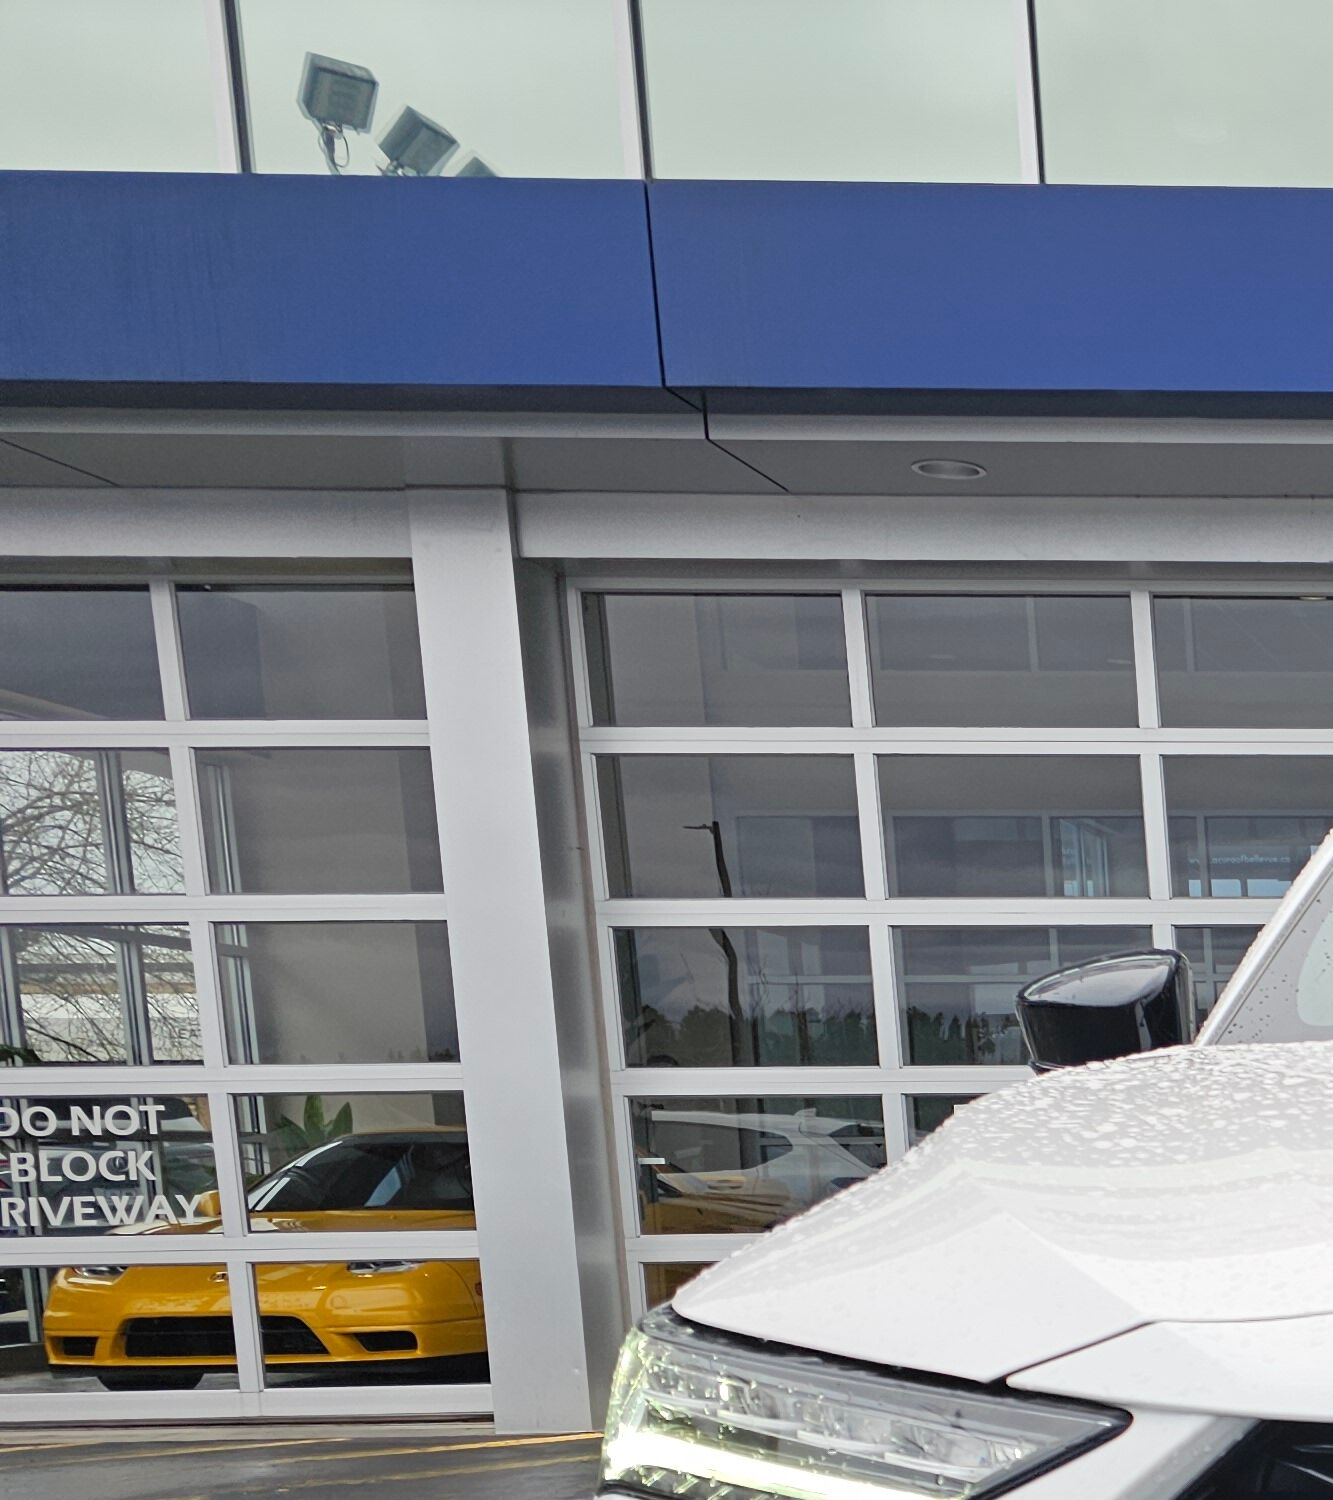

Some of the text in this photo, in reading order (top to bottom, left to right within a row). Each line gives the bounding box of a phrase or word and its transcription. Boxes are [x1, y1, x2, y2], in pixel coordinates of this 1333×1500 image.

[0, 1104, 166, 1137] DO NOT
[10, 1150, 157, 1182] BLOCK
[1, 1194, 203, 1227] RIVEWAY
